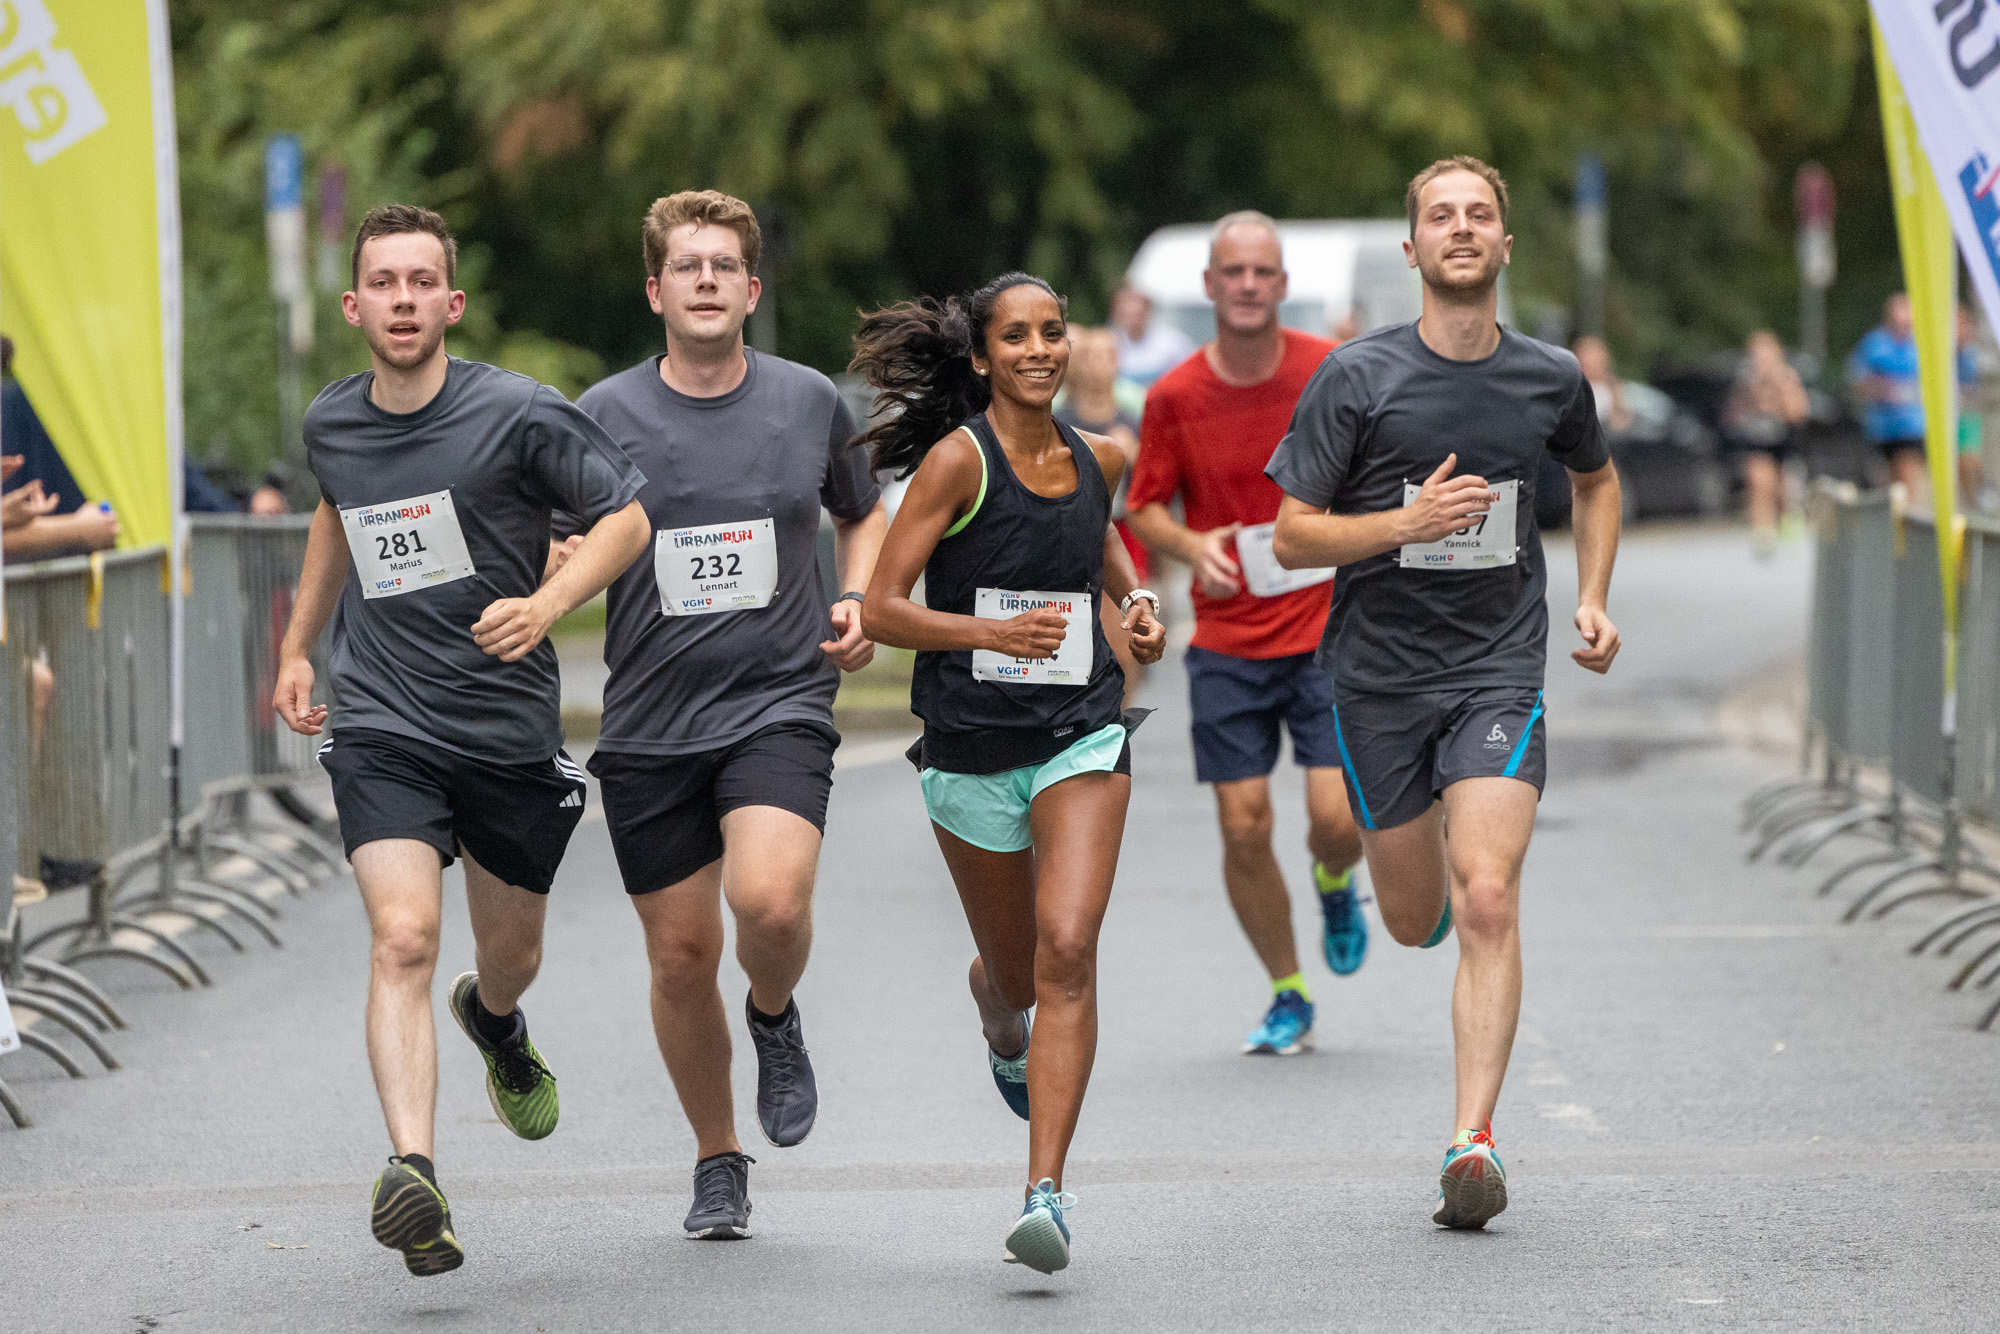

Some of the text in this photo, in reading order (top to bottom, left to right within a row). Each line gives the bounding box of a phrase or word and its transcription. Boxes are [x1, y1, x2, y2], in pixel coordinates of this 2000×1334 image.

[375, 529, 427, 561] 281
[1444, 539, 1482, 548] Yannick
[1424, 554, 1447, 562] VGH
[389, 558, 423, 572] Marius
[690, 553, 743, 580] 232
[375, 579, 395, 590] VGH
[700, 581, 738, 592] Lennart
[682, 598, 705, 608] VGH
[996, 666, 1021, 675] VGH
